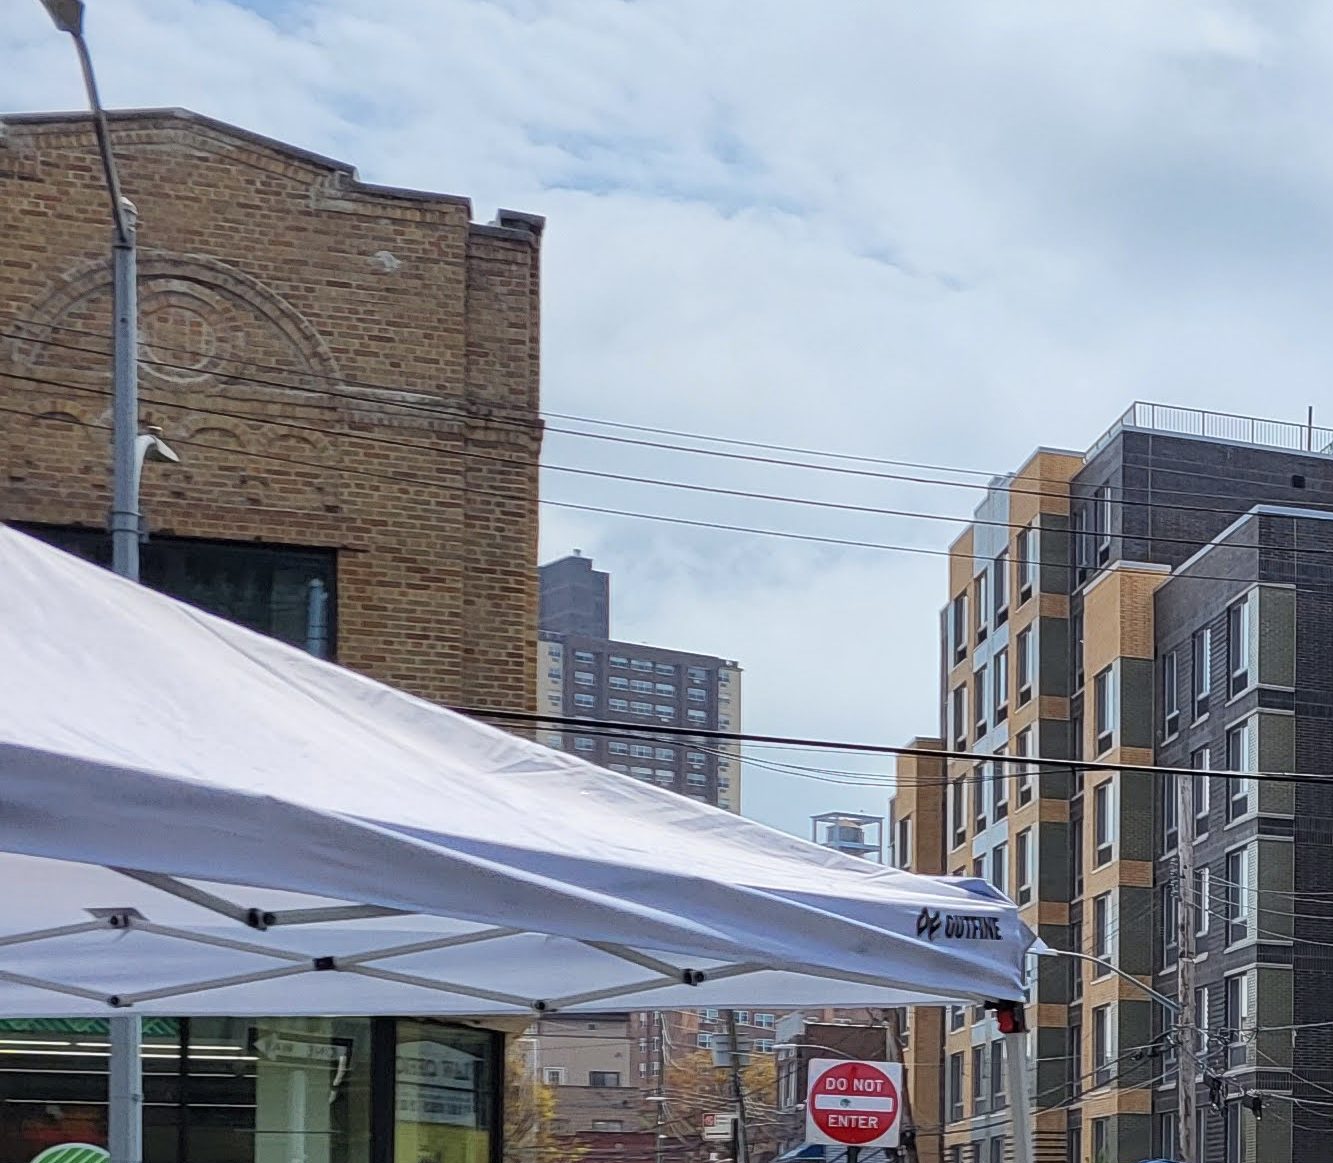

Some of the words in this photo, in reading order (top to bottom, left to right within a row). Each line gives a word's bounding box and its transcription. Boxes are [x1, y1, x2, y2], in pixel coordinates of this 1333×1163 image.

[945, 915, 1003, 940] OUTFINE
[825, 1077, 847, 1091] DO
[853, 1078, 884, 1093] NOT
[827, 1115, 878, 1129] ENTER
